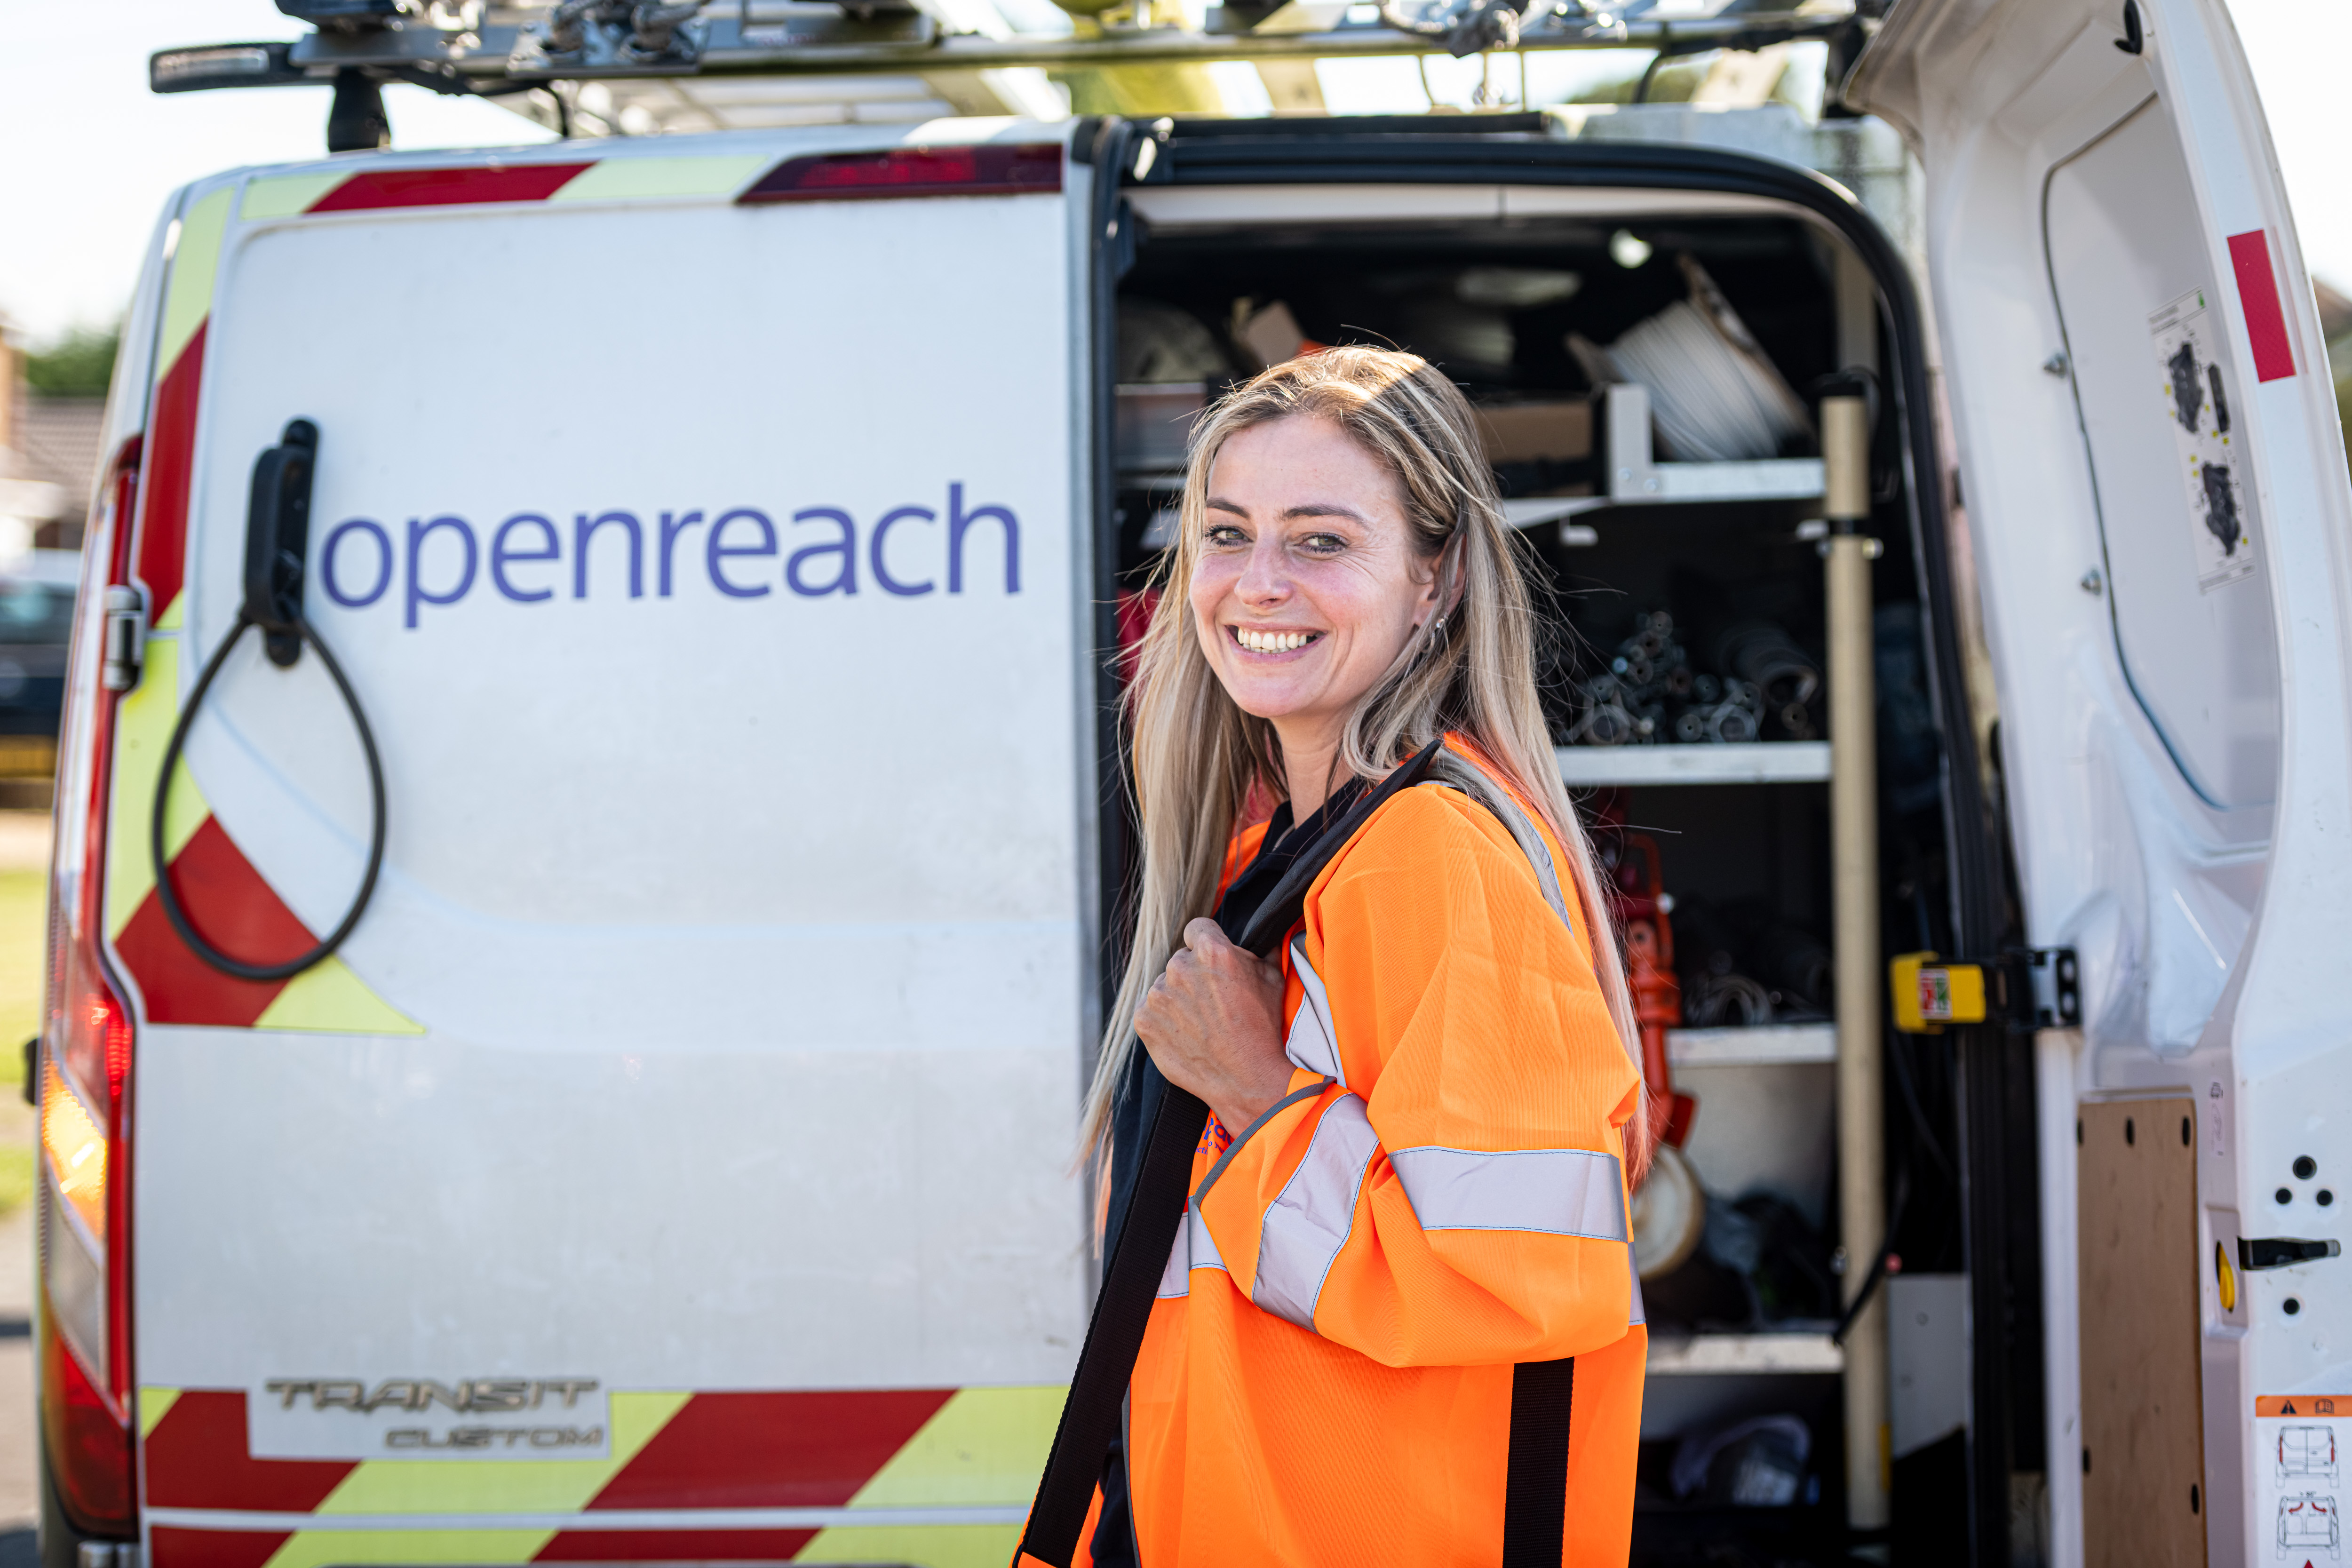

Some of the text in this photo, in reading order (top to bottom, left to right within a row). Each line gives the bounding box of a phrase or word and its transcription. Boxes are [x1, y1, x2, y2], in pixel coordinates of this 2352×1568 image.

[317, 481, 1022, 630] openreach
[266, 1377, 600, 1413] TRANSIT
[384, 1426, 603, 1448] CUSTOM
